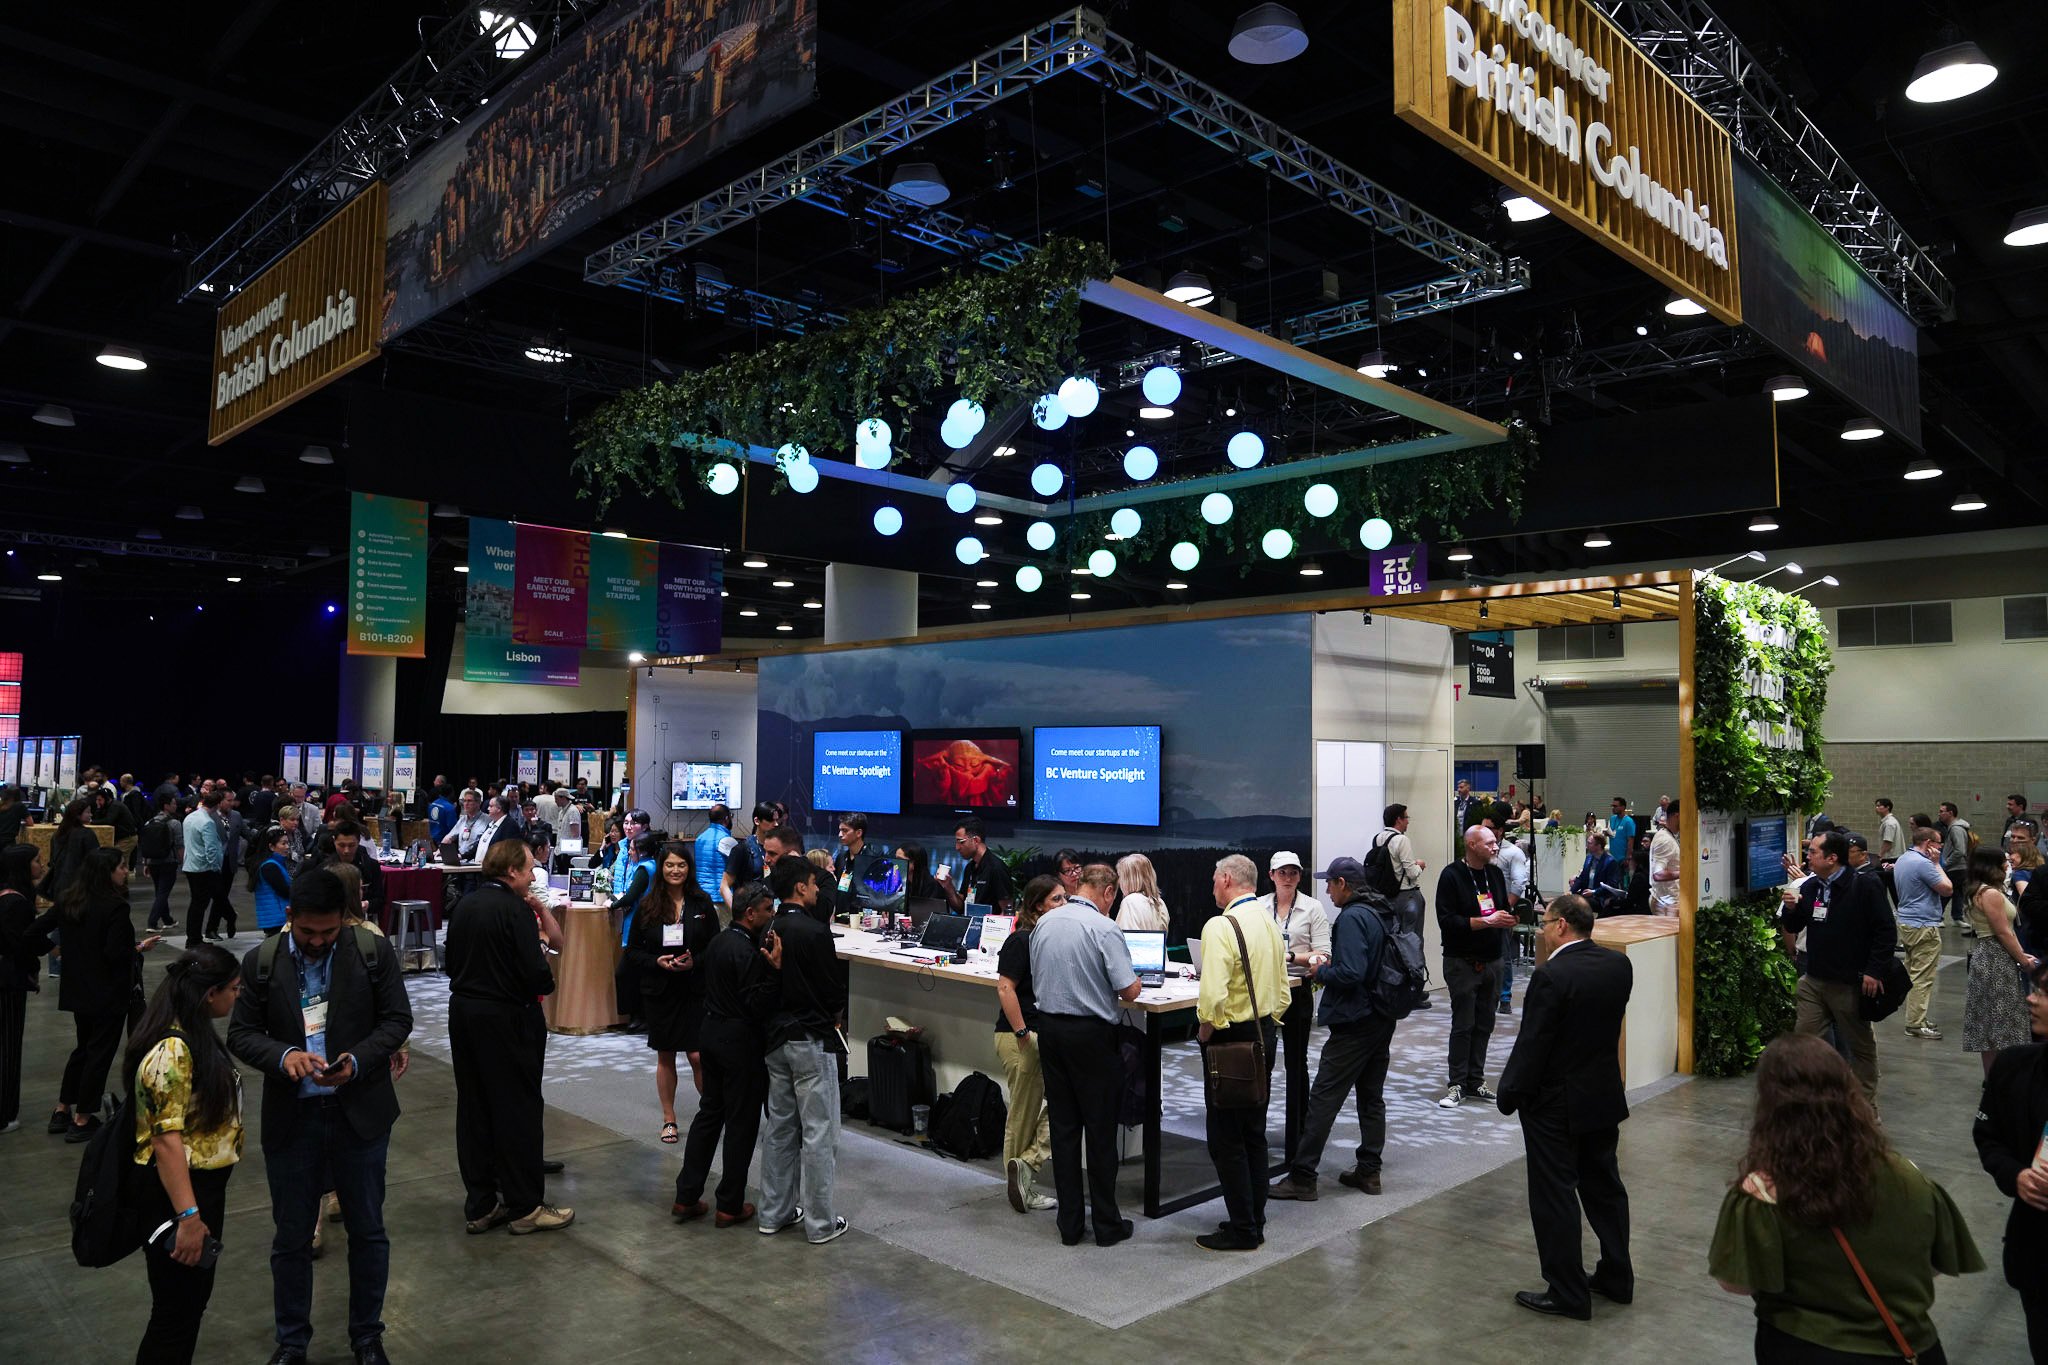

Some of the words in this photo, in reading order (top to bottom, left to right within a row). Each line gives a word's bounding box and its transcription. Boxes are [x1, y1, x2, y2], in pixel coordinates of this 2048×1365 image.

[1474, 0, 1612, 104] couver
[1444, 5, 1580, 165] British
[1585, 121, 1729, 271] Columbia
[221, 291, 288, 358] Vancouver
[216, 344, 266, 410] British
[268, 288, 356, 376] Columbia
[533, 576, 553, 584] MEET
[554, 578, 570, 586] OUR
[526, 583, 576, 594] EARLY-STAGE
[612, 585, 635, 593] RISING
[664, 584, 715, 594] GROWTH-STAGE
[533, 592, 570, 601] STARTUPS
[605, 592, 641, 601] STARTUPS
[673, 592, 706, 601] STARTUPS
[359, 632, 414, 644] B101-B200
[506, 651, 541, 663] Lisbon
[1485, 646, 1495, 658] 04
[1476, 667, 1491, 676] FOOD
[1476, 675, 1495, 684] SUMMIT
[857, 749, 873, 757] startups
[1050, 748, 1067, 756] Come
[1096, 749, 1120, 758] startups
[1121, 749, 1128, 757] at
[1129, 748, 1140, 757] the
[821, 765, 831, 775] BC
[832, 765, 858, 775] Venture
[859, 765, 891, 778] Spotlight
[1045, 767, 1059, 779] BC
[1060, 767, 1098, 780] Venture
[1100, 768, 1145, 783] Spotlight
